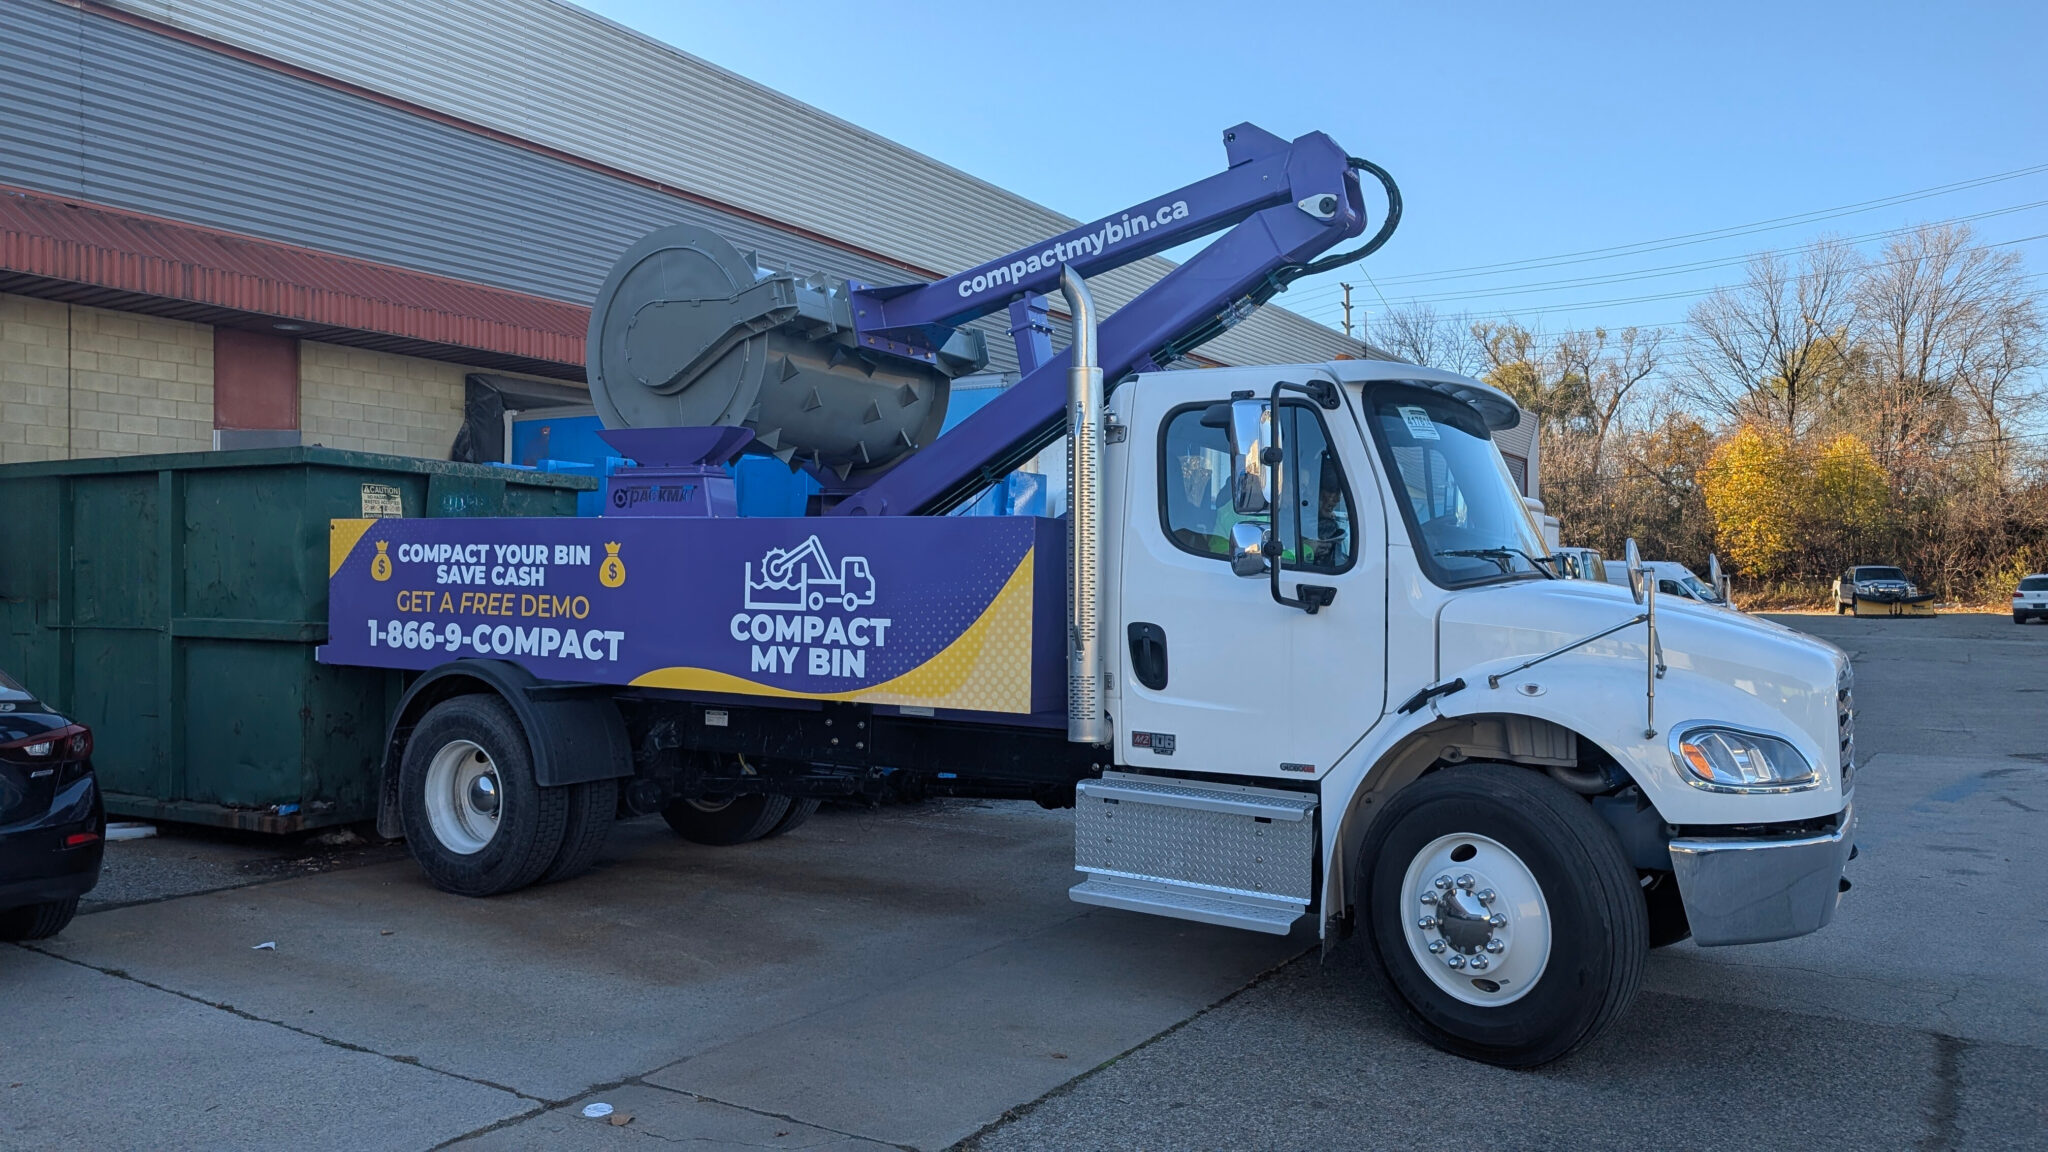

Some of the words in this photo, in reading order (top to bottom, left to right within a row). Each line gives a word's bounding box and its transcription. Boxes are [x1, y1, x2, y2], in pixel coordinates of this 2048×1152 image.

[958, 200, 1190, 298] compactmybin.ca
[370, 486, 399, 495] CAUTION
[398, 544, 489, 564] COMPACT
[494, 544, 548, 565] YOUR
[554, 545, 590, 565] BIN
[436, 565, 486, 585] SAVE
[491, 566, 545, 586] CASH
[397, 590, 435, 613] GET
[439, 592, 454, 614] A
[459, 592, 516, 616] FREE
[521, 595, 590, 619] DEMO
[368, 619, 625, 661] 1-866-9-COMPACT
[730, 613, 891, 647] COMPACT
[751, 645, 800, 674] MY
[808, 647, 866, 678] BIN
[1134, 734, 1149, 745] M2
[1151, 734, 1174, 749] 106
